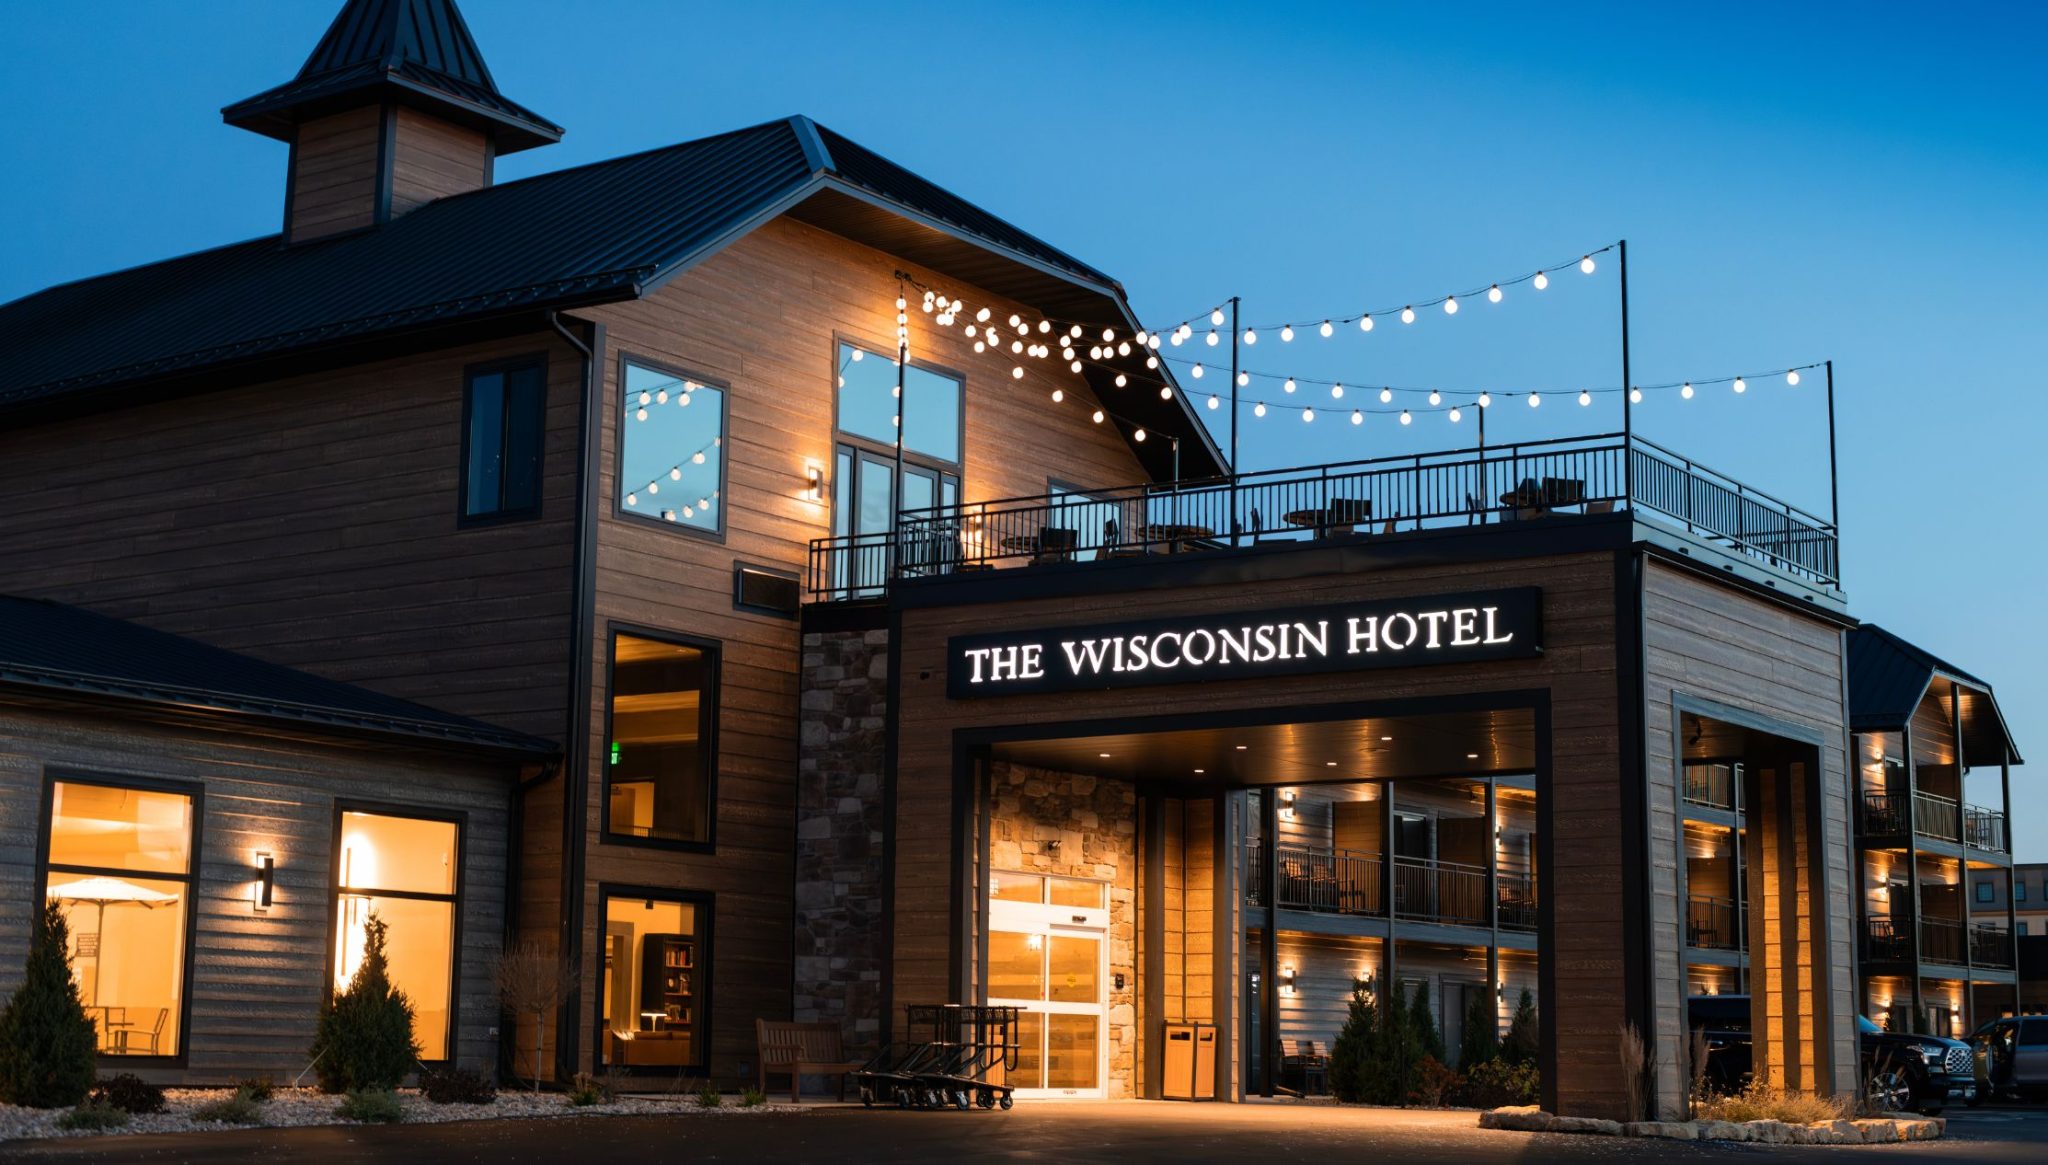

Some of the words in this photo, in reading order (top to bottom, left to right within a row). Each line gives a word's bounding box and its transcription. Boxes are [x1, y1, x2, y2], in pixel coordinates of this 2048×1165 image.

[964, 645, 1045, 683] THE
[1060, 620, 1329, 676] WISCONSIN
[1347, 606, 1514, 655] HOTEL
